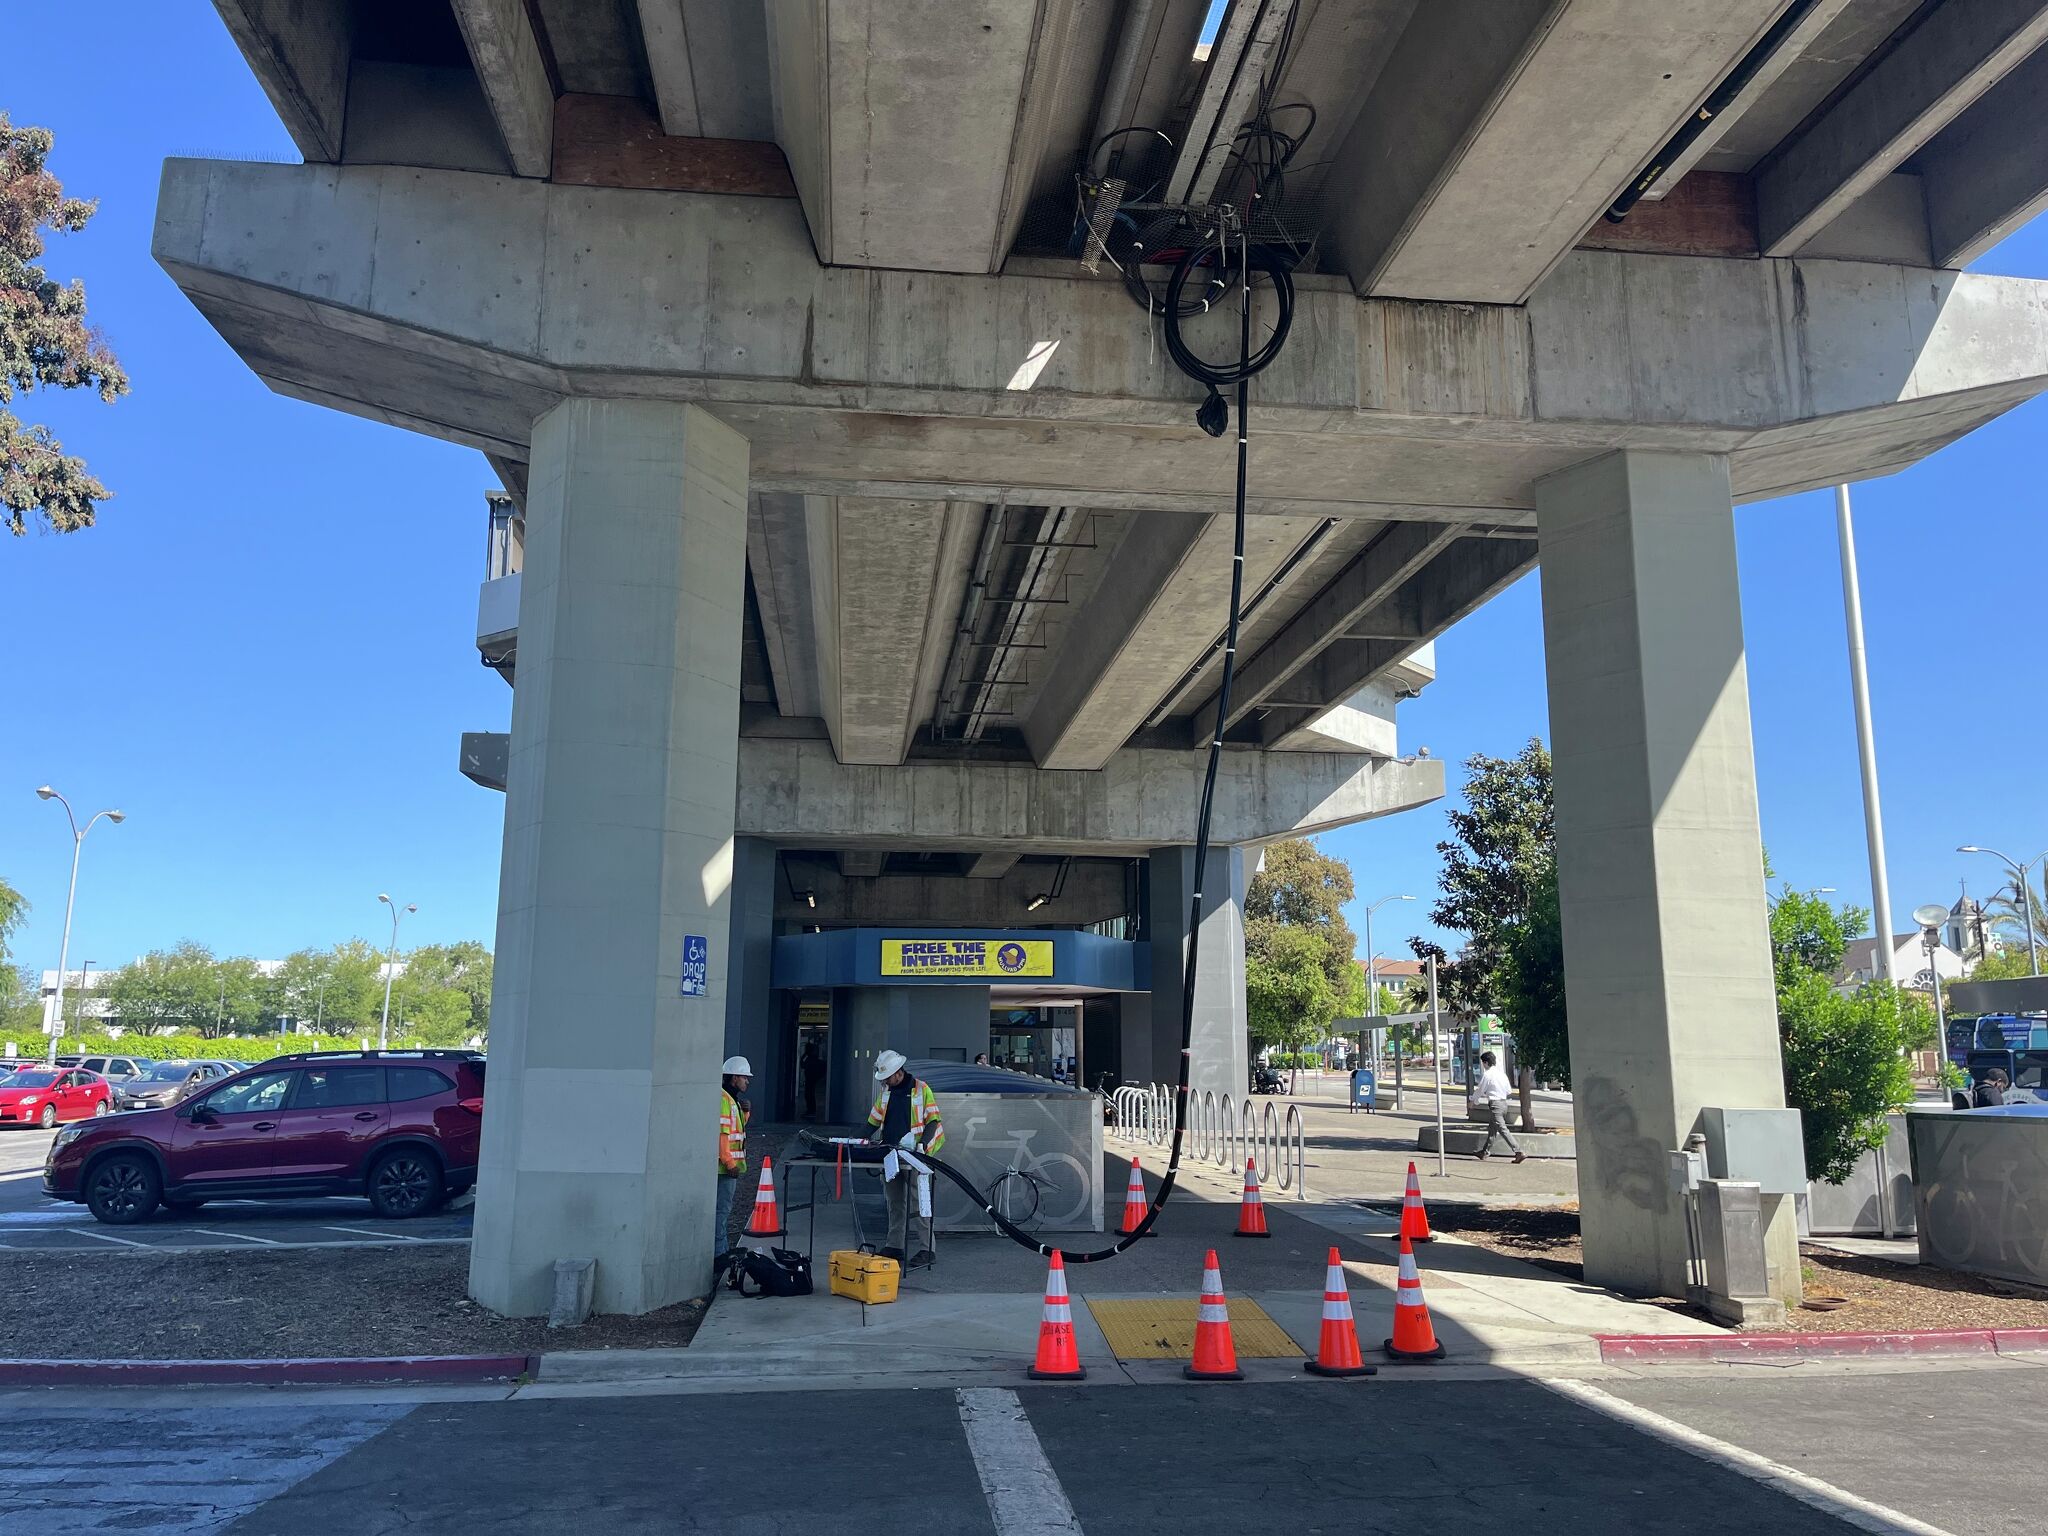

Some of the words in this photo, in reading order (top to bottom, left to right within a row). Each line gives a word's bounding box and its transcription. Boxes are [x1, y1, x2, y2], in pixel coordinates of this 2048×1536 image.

[902, 942, 947, 954] FREE
[952, 942, 986, 953] THE
[902, 954, 986, 967] INTERNET
[999, 956, 1018, 972] MULLVAD
[683, 962, 705, 979] DROP
[683, 979, 705, 994] FF
